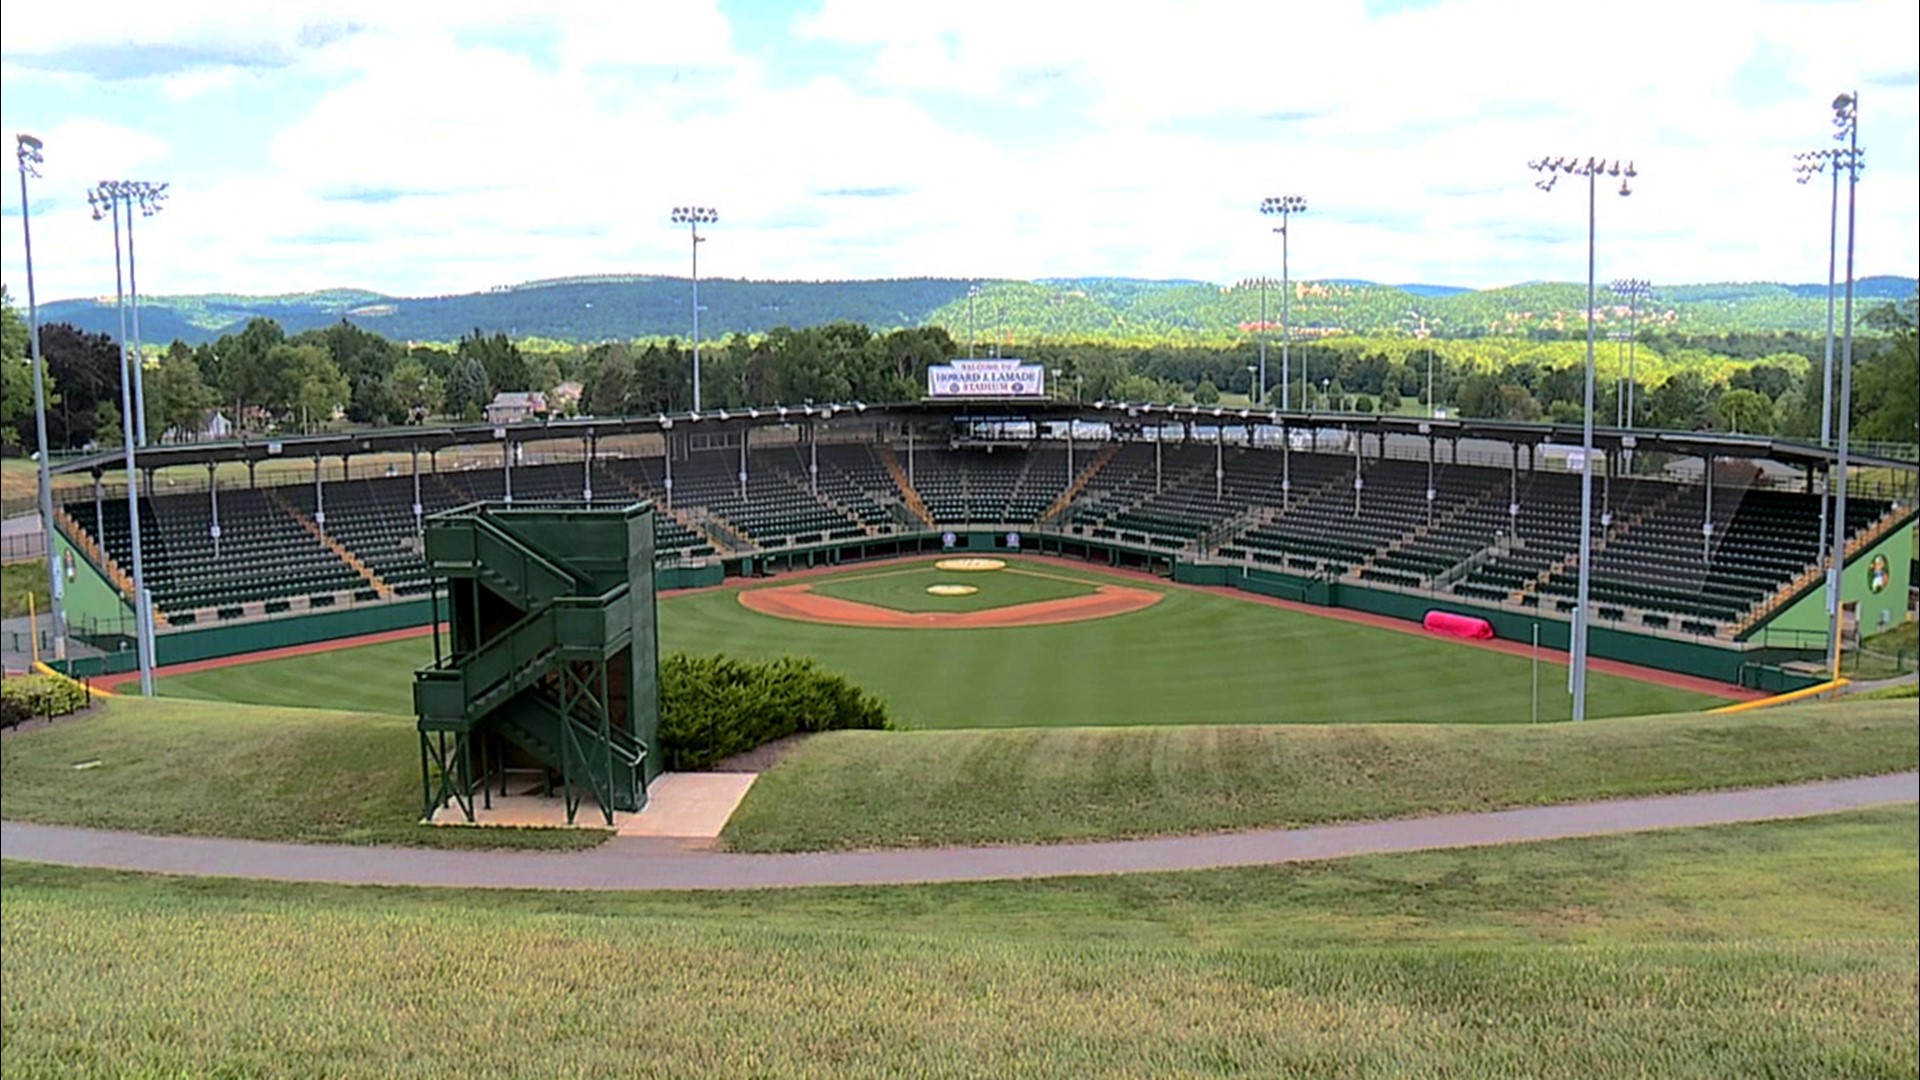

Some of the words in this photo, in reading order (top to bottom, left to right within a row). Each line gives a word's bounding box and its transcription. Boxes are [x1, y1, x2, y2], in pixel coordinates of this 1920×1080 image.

[936, 373, 980, 381] HOWARD
[991, 373, 1035, 381] LAMADE
[963, 383, 1008, 391] STADIUM
